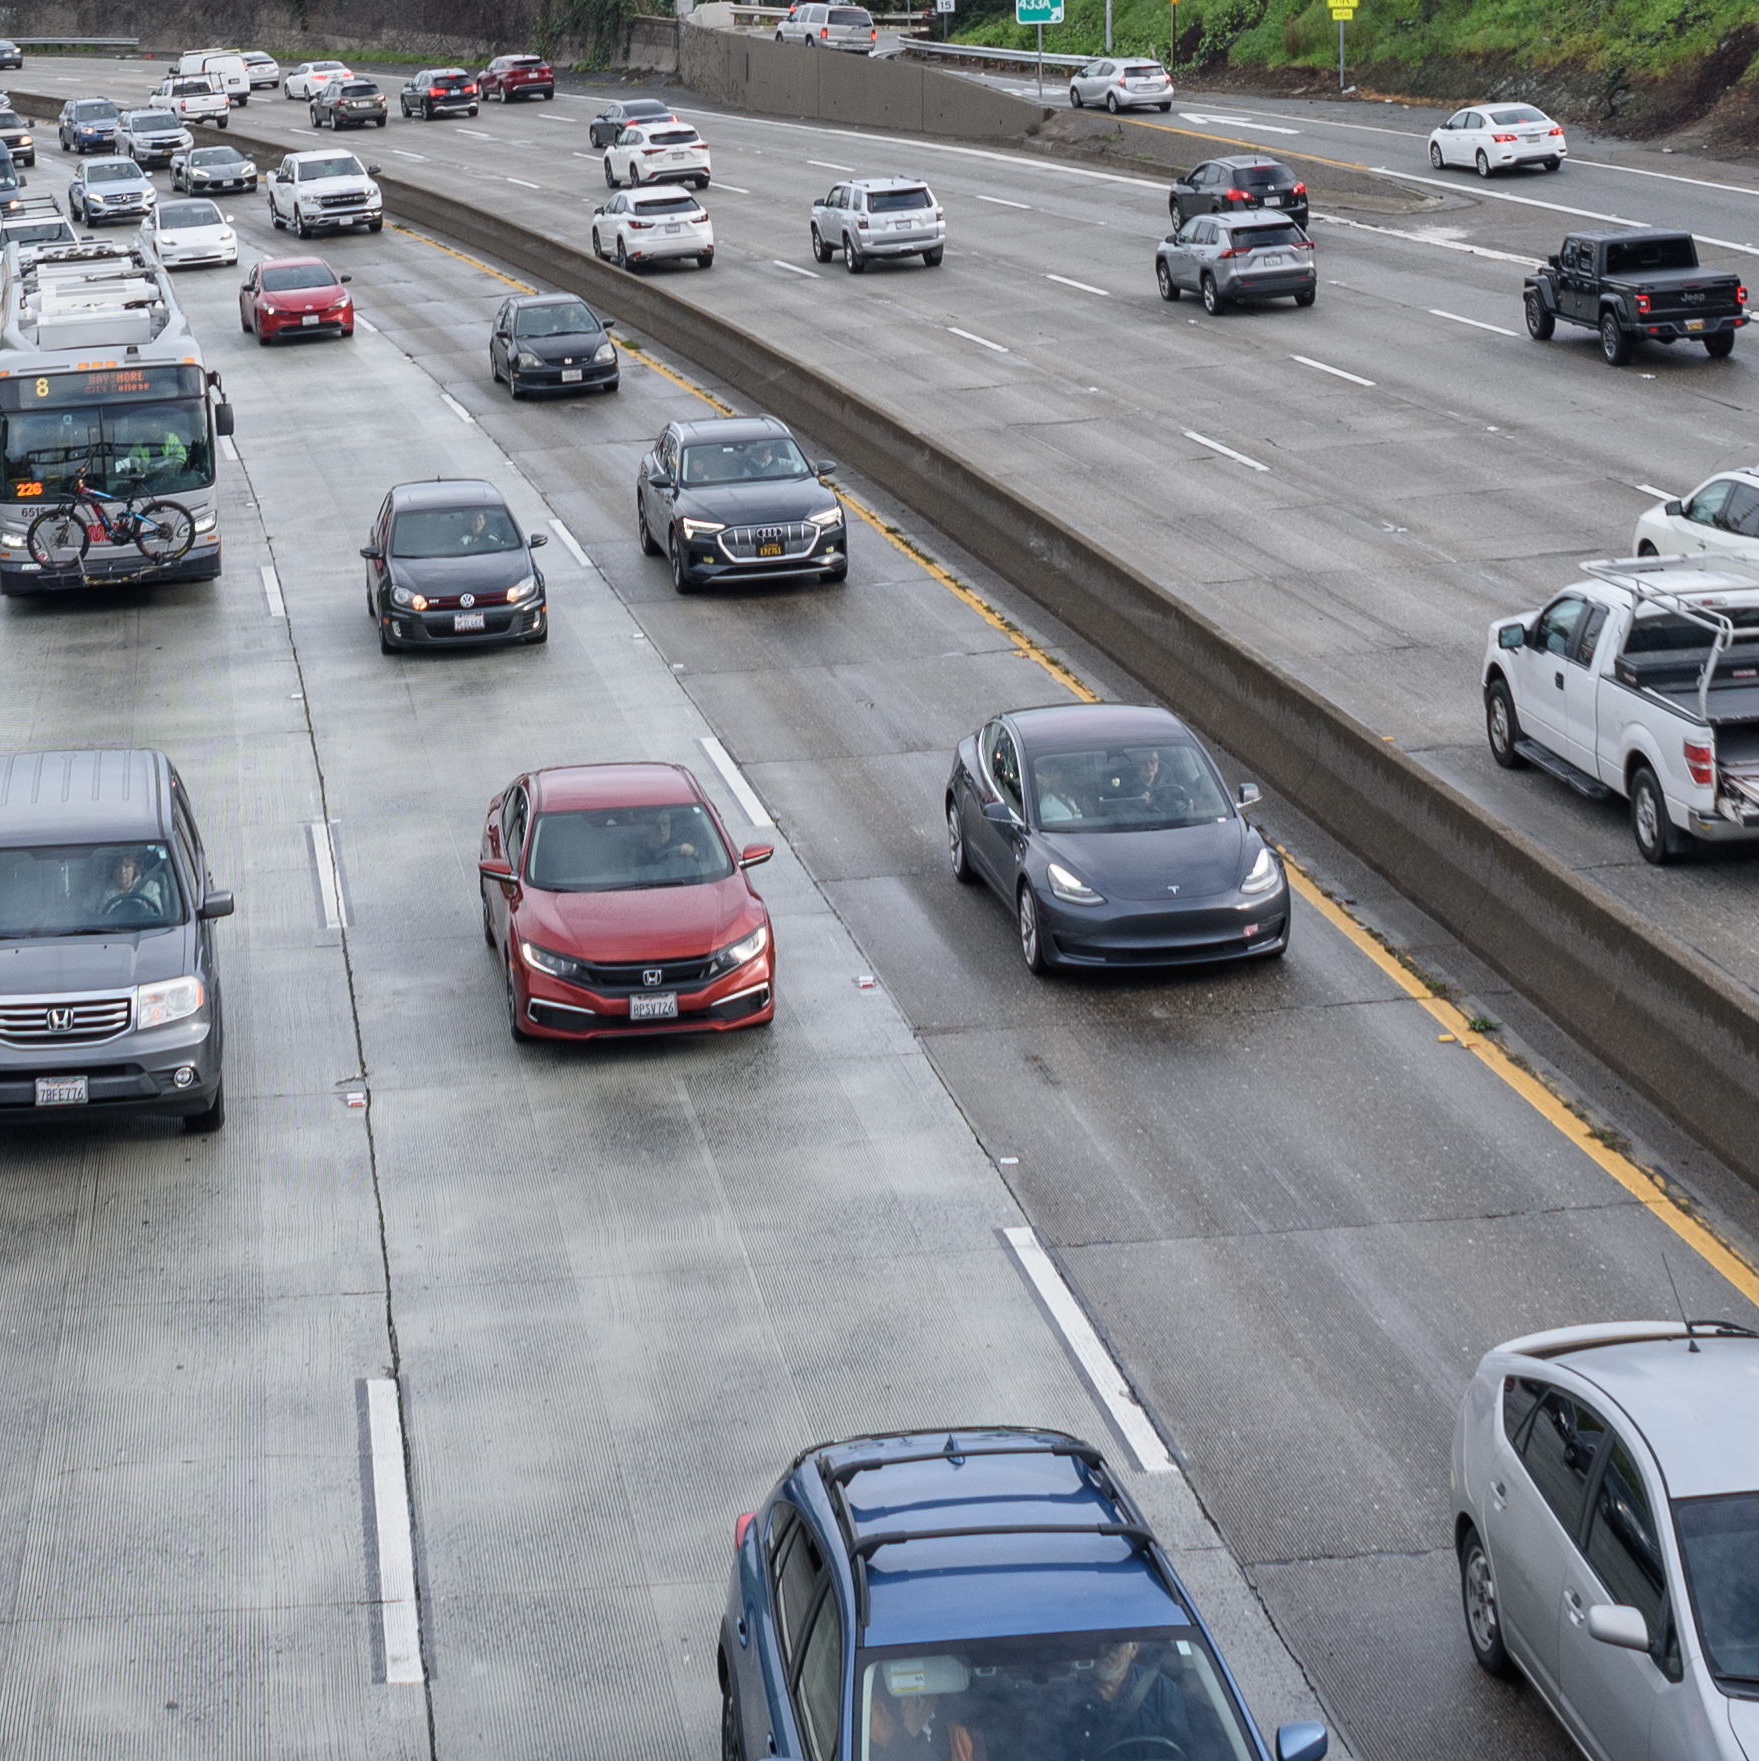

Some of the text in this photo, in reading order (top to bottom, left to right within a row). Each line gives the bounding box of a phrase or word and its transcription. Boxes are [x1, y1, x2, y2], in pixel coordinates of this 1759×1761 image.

[940, 1, 952, 10] 15
[1680, 292, 1706, 302] Jeep
[88, 370, 144, 385] BAYSHORE
[36, 377, 49, 397] 8
[111, 382, 150, 392] College
[16, 481, 43, 497] 226
